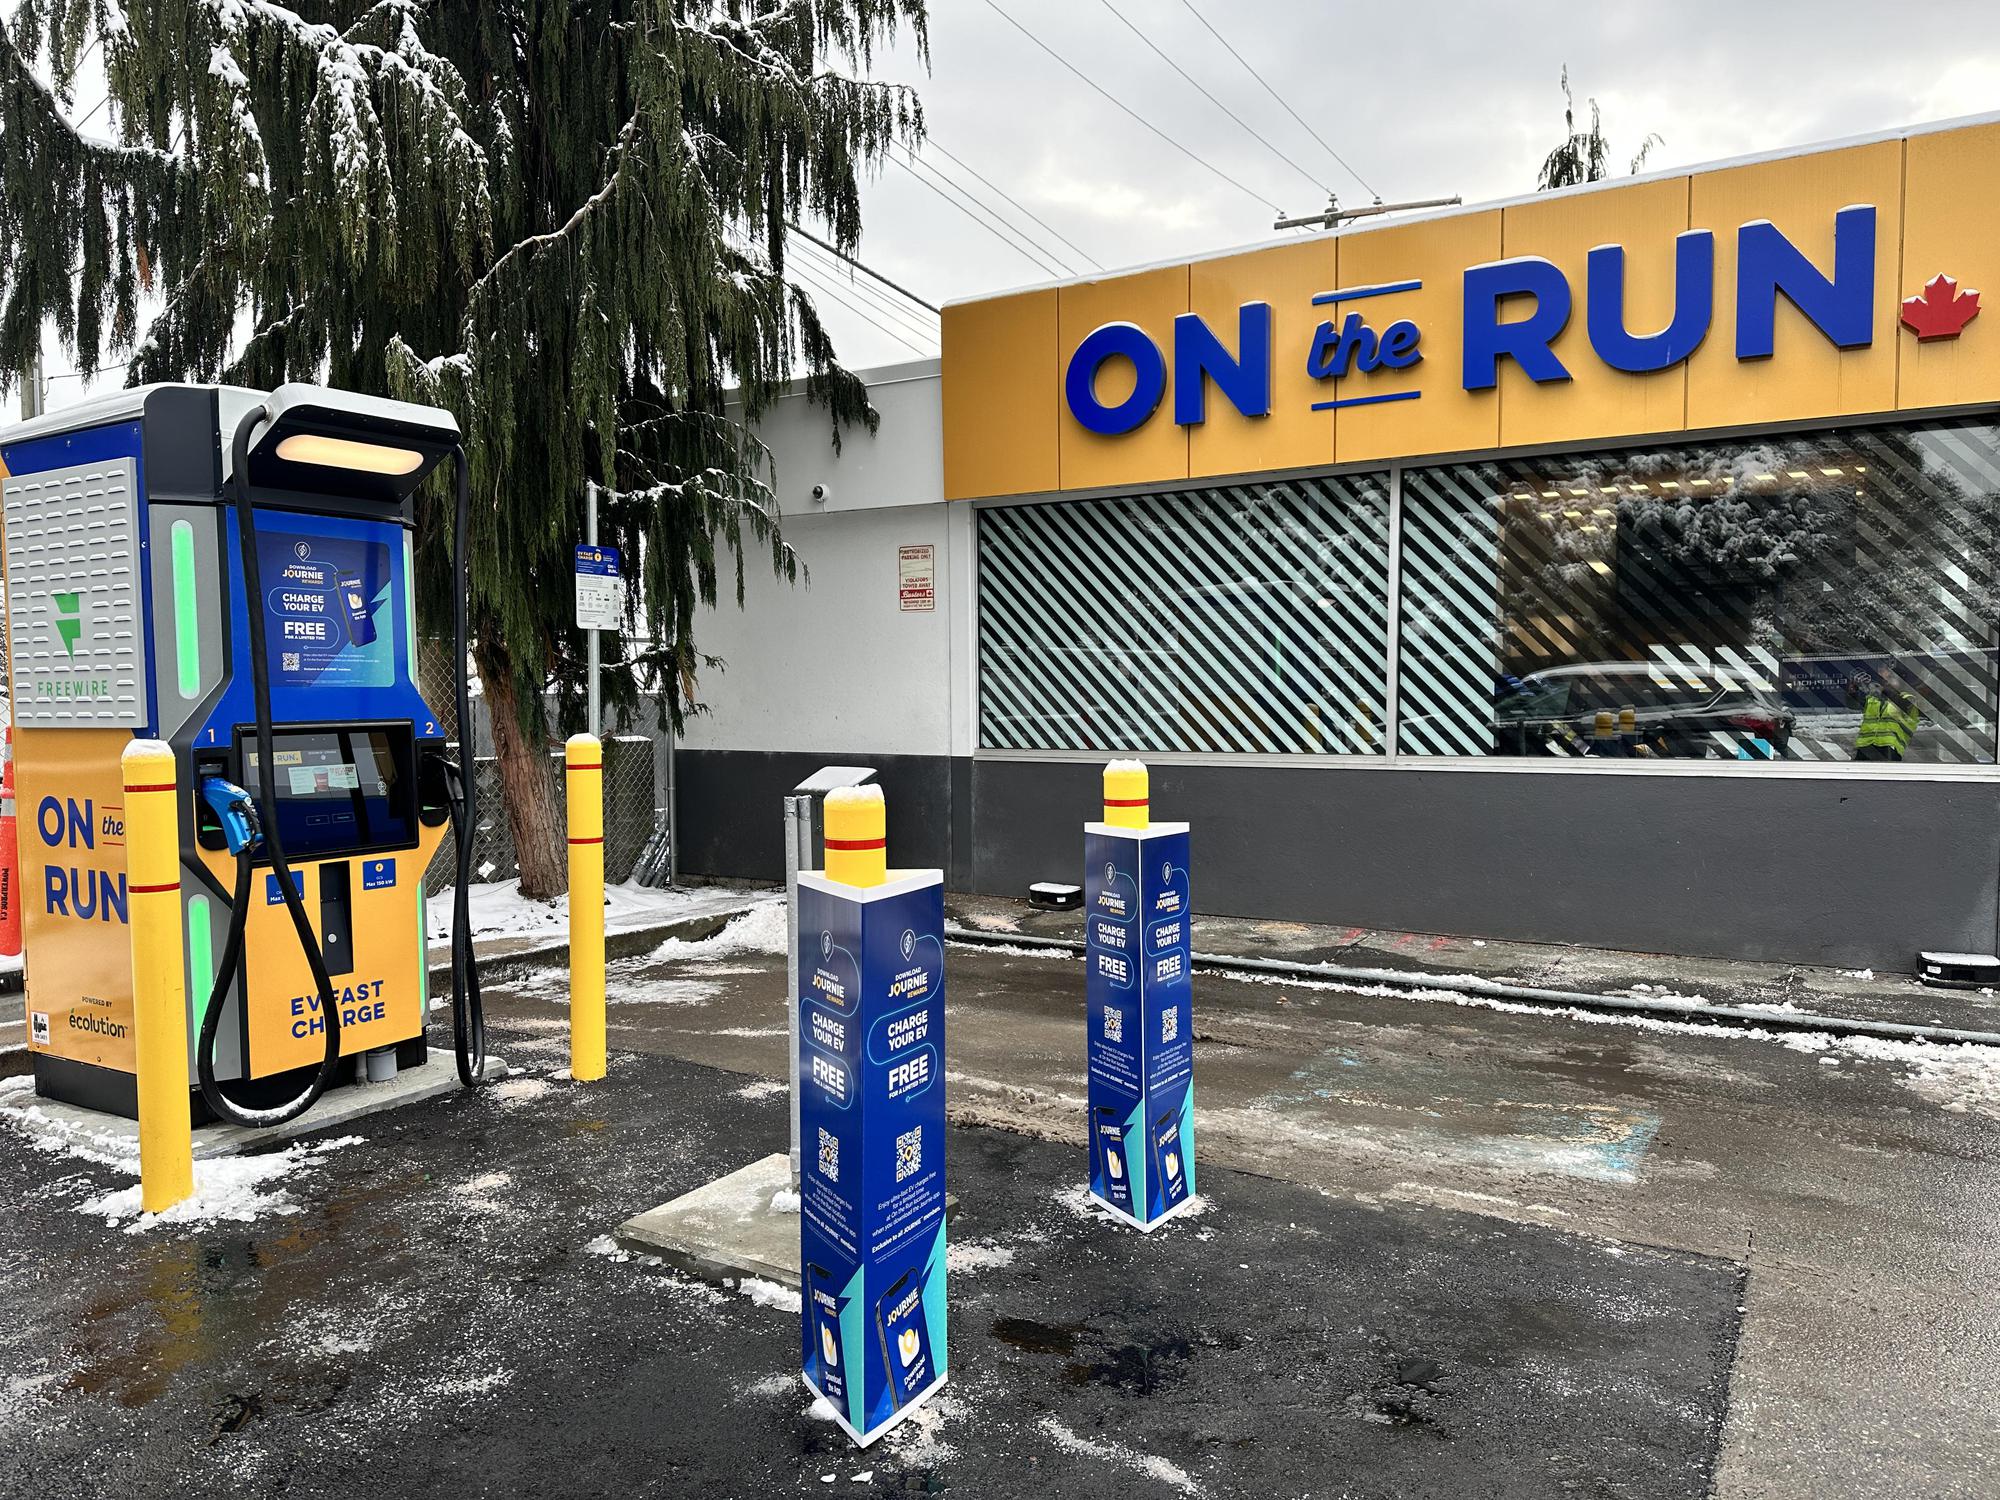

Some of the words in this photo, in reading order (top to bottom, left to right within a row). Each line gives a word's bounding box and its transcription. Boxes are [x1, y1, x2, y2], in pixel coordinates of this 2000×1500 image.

[1066, 301, 1271, 434] ON
[1307, 312, 1423, 379] the
[1463, 204, 1876, 391] RUN
[282, 570, 324, 579] JOURNIE
[283, 593, 324, 603] CHARGE
[284, 603, 309, 611] YOUR
[284, 622, 325, 635] FREE
[38, 680, 107, 696] FREEWIRE
[208, 728, 215, 743] 1
[426, 722, 434, 734] 2
[38, 796, 94, 849] ON
[102, 816, 124, 835] the
[45, 865, 128, 924] RUN
[1098, 896, 1125, 909] JOURNIE
[1098, 923, 1125, 938] CHARGE
[1156, 923, 1180, 938] CHARGE
[1098, 933, 1115, 946] YOUR
[1117, 939, 1125, 948] EV
[1156, 935, 1172, 948] YOUR
[1173, 933, 1180, 942] EV
[895, 967, 921, 981] DOWNLOAD
[1098, 955, 1126, 976] FREE
[1157, 955, 1180, 976] FREE
[817, 968, 839, 982] DOWNLOAD
[812, 974, 844, 998] JOURNIE
[888, 972, 928, 997] JOURNIE
[907, 986, 928, 998] REWARDS
[82, 996, 105, 1006] POWERED
[291, 992, 321, 1016] EV
[292, 1002, 385, 1038] CHRGE
[812, 1012, 844, 1038] CHARGE
[888, 1010, 928, 1038] CHARGE
[813, 1026, 832, 1047] YOUR
[834, 1038, 844, 1052] EV
[889, 1030, 914, 1051] YOUR
[916, 1024, 928, 1040] EV
[813, 1055, 844, 1092] FREE
[889, 1054, 928, 1091] FREE
[889, 1090, 898, 1099] FOR
[903, 1081, 918, 1092] LIMITED
[887, 1286, 918, 1327] JOURNIE
[904, 1354, 925, 1385] Download
[916, 1367, 925, 1380] App
